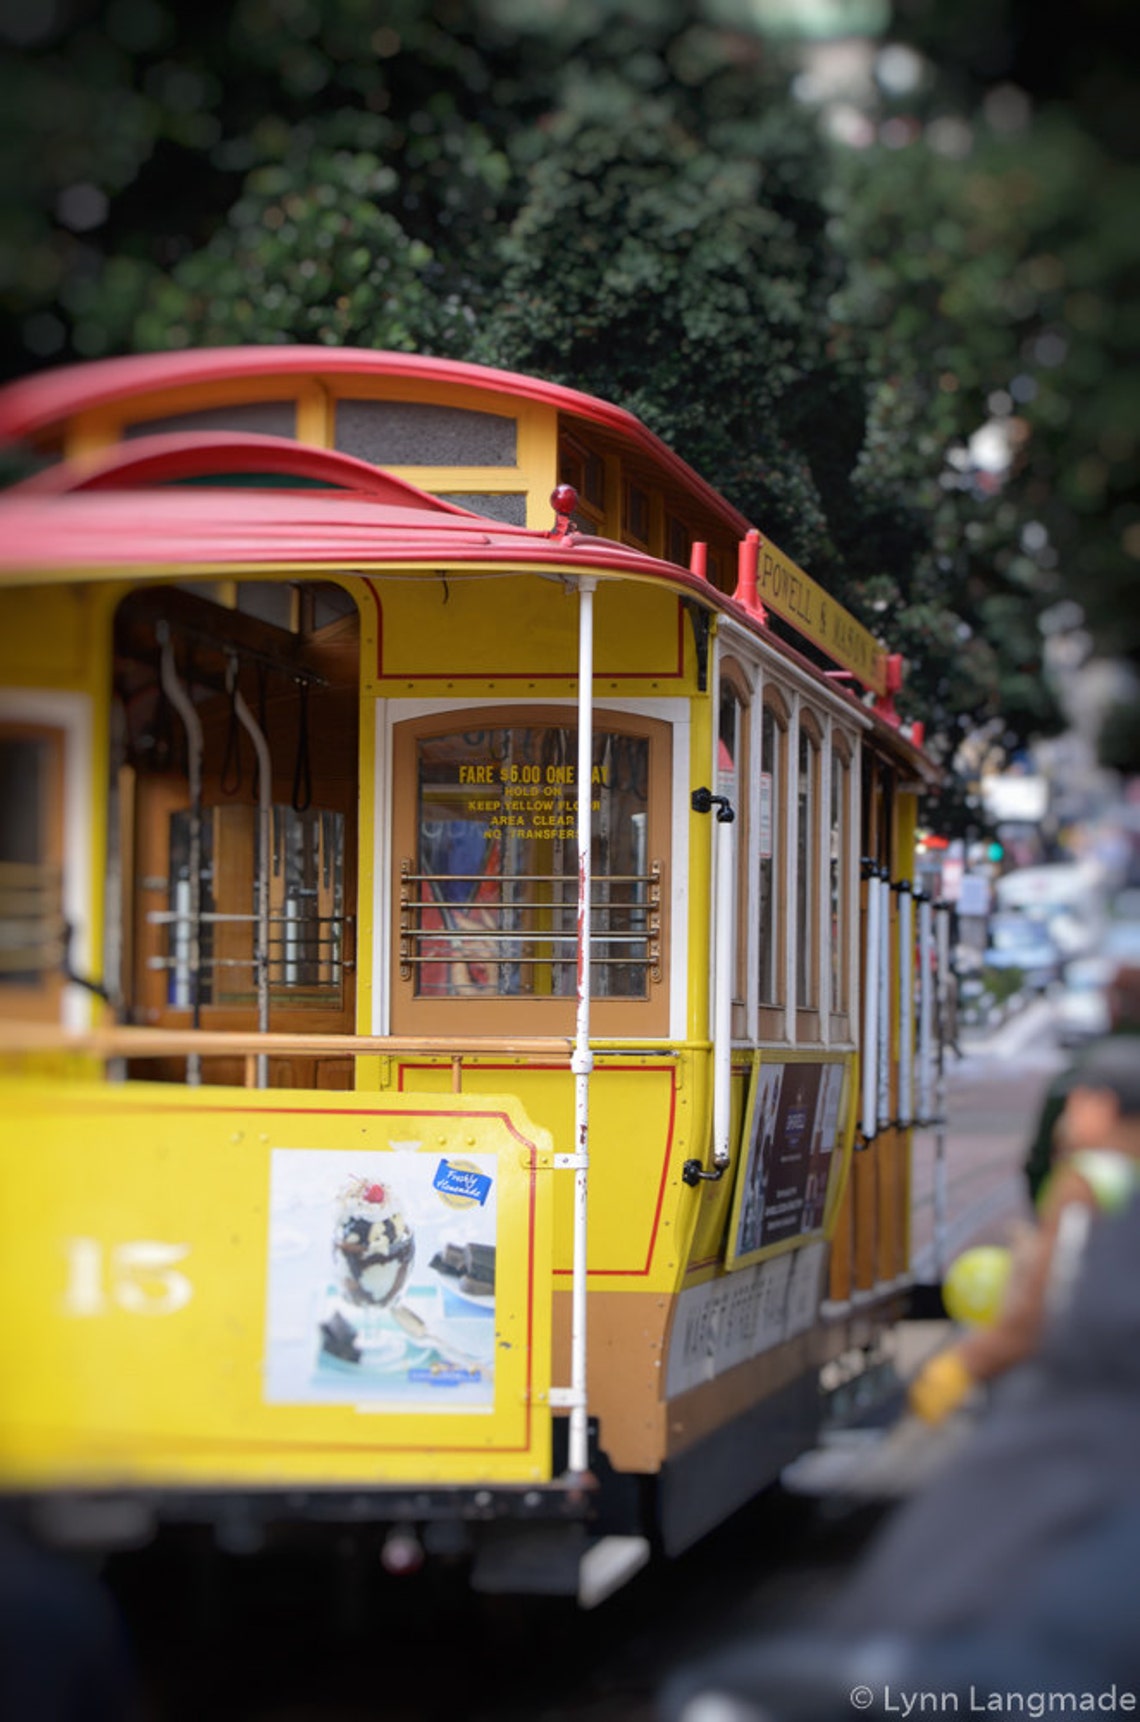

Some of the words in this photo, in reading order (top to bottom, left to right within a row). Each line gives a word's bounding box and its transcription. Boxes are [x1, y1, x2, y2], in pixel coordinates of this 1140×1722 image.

[761, 553, 812, 625] POWELL
[459, 765, 494, 784] FARE
[500, 764, 541, 784] $6.00
[546, 765, 575, 784] ONE
[504, 786, 540, 797] HOLD
[543, 786, 562, 797] ON
[468, 800, 501, 811] KEEP
[504, 800, 554, 811] YELLOW
[490, 815, 525, 826] AREA
[532, 815, 575, 826] CLEAR
[484, 829, 502, 839] NO
[511, 829, 579, 839] TRANSFER
[62, 1236, 193, 1319] 15
